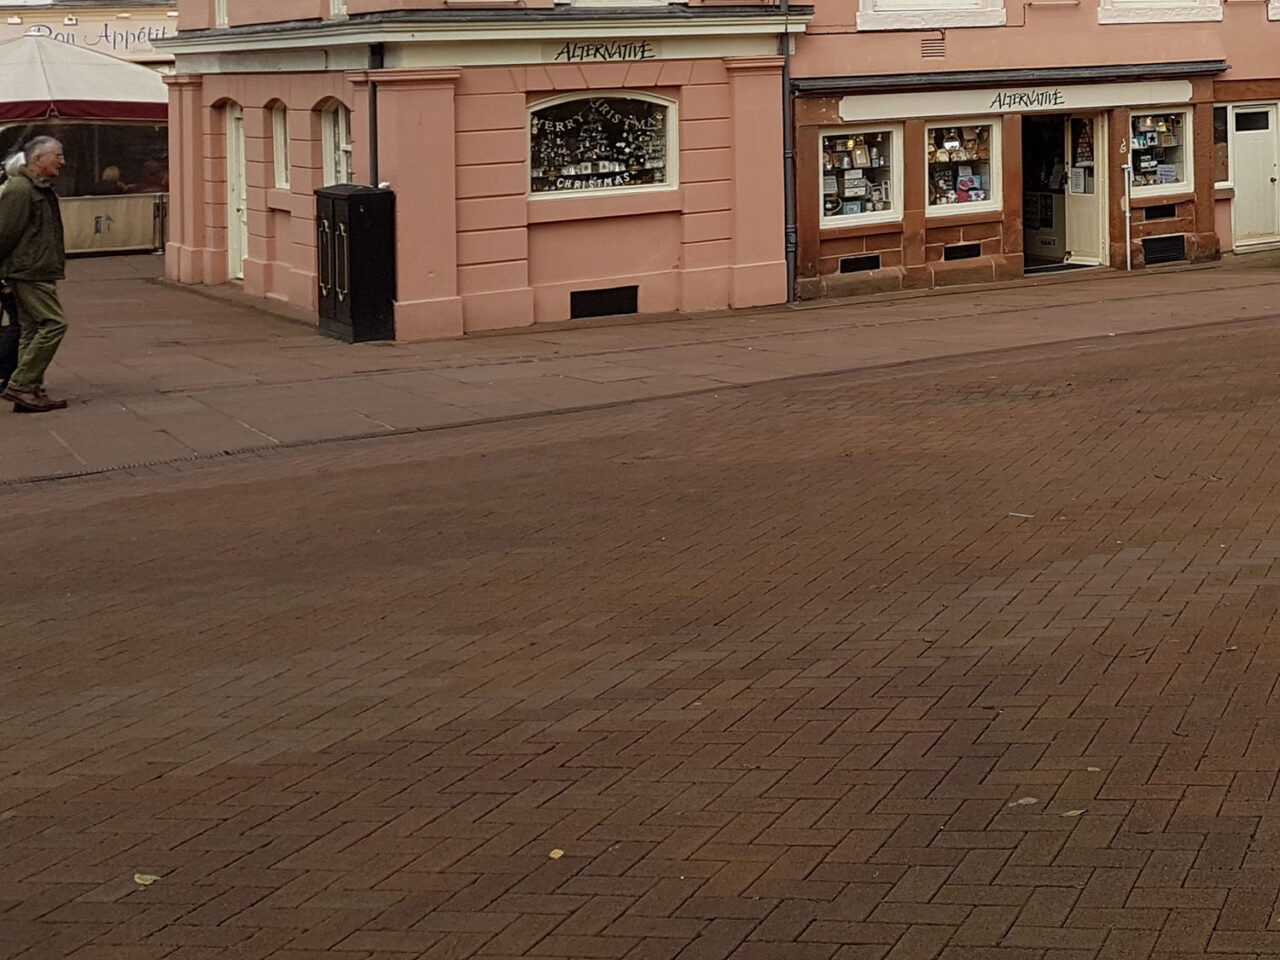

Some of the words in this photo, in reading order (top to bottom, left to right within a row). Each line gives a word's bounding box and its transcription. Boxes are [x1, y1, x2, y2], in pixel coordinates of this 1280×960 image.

[554, 40, 656, 61] ALTERNATIVE
[990, 88, 1065, 109] ALTERNATIVE
[556, 172, 630, 189] CHRISTMAS
